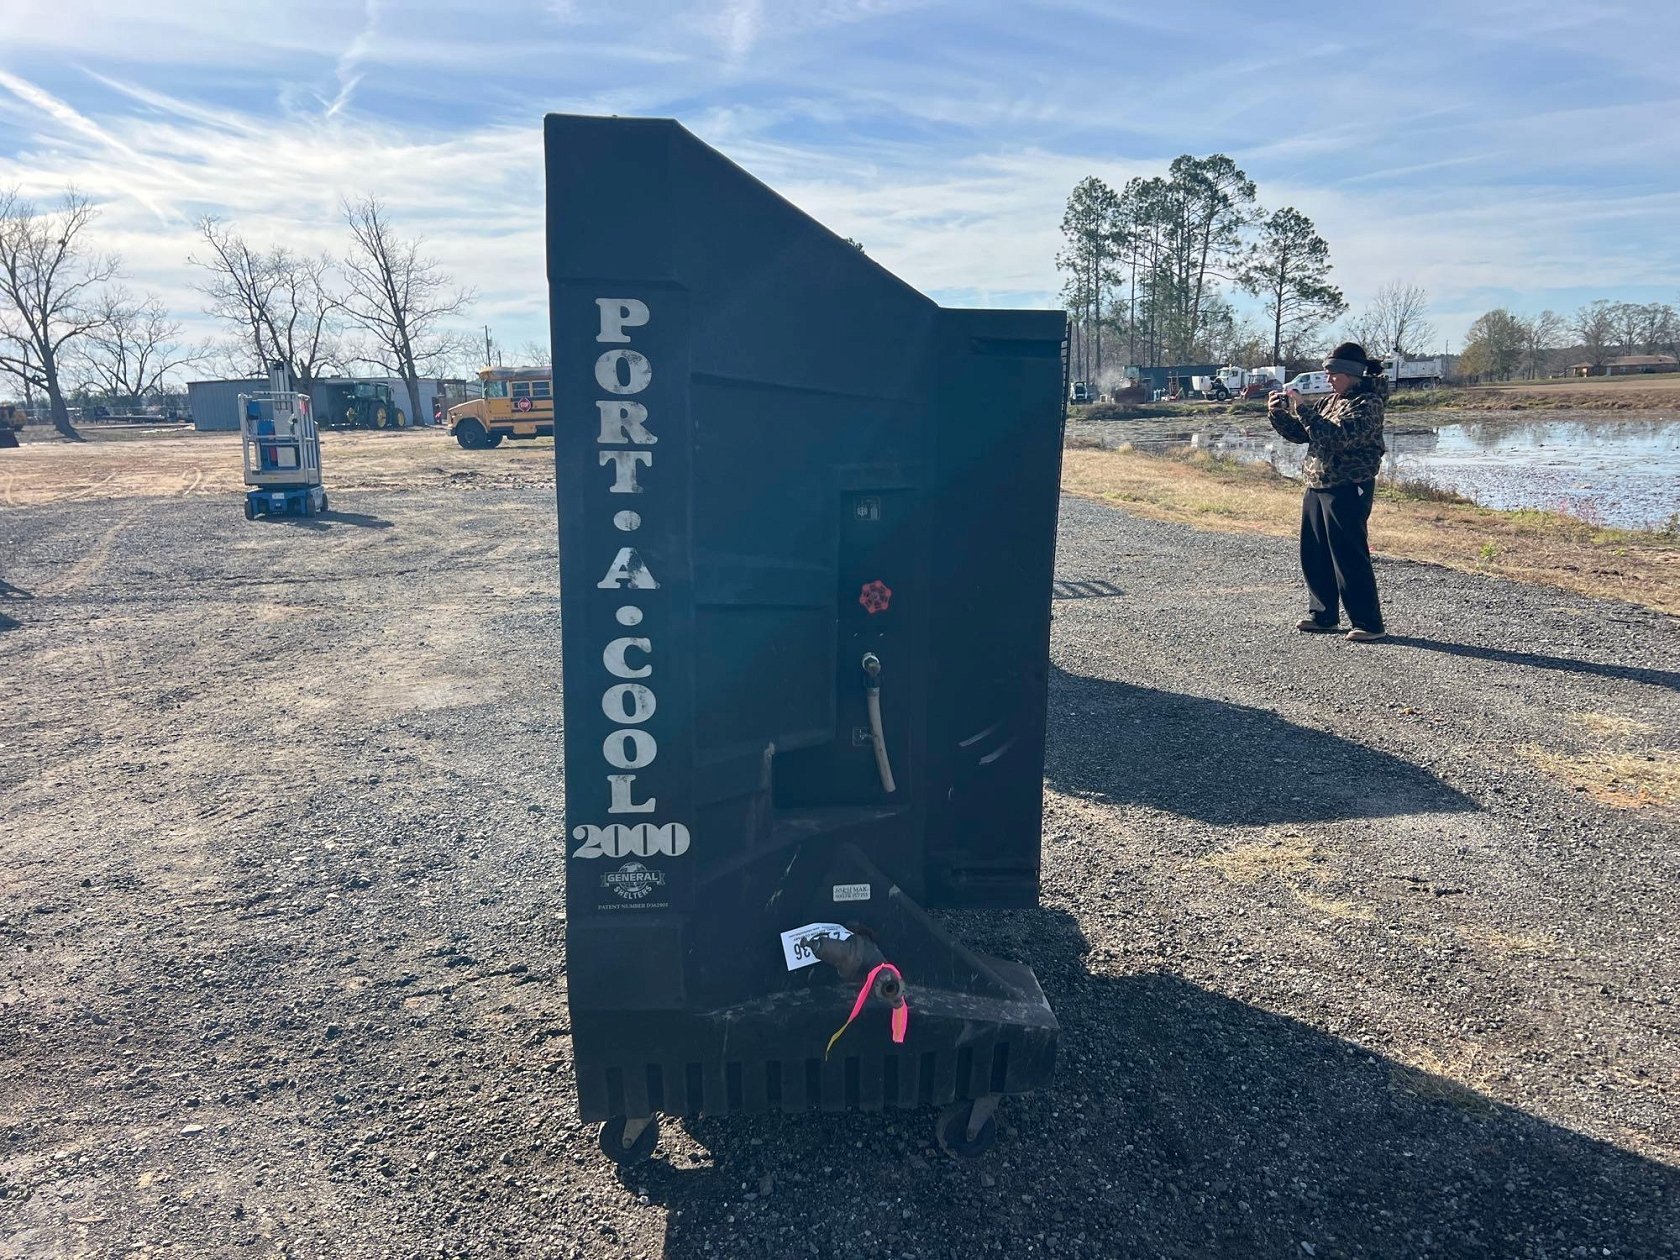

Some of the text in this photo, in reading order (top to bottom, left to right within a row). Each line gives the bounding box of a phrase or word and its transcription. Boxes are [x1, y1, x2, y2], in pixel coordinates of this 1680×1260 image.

[572, 823, 691, 859] 2000
[607, 872, 658, 882] GENERAL
[613, 885, 652, 900] SHELTERS
